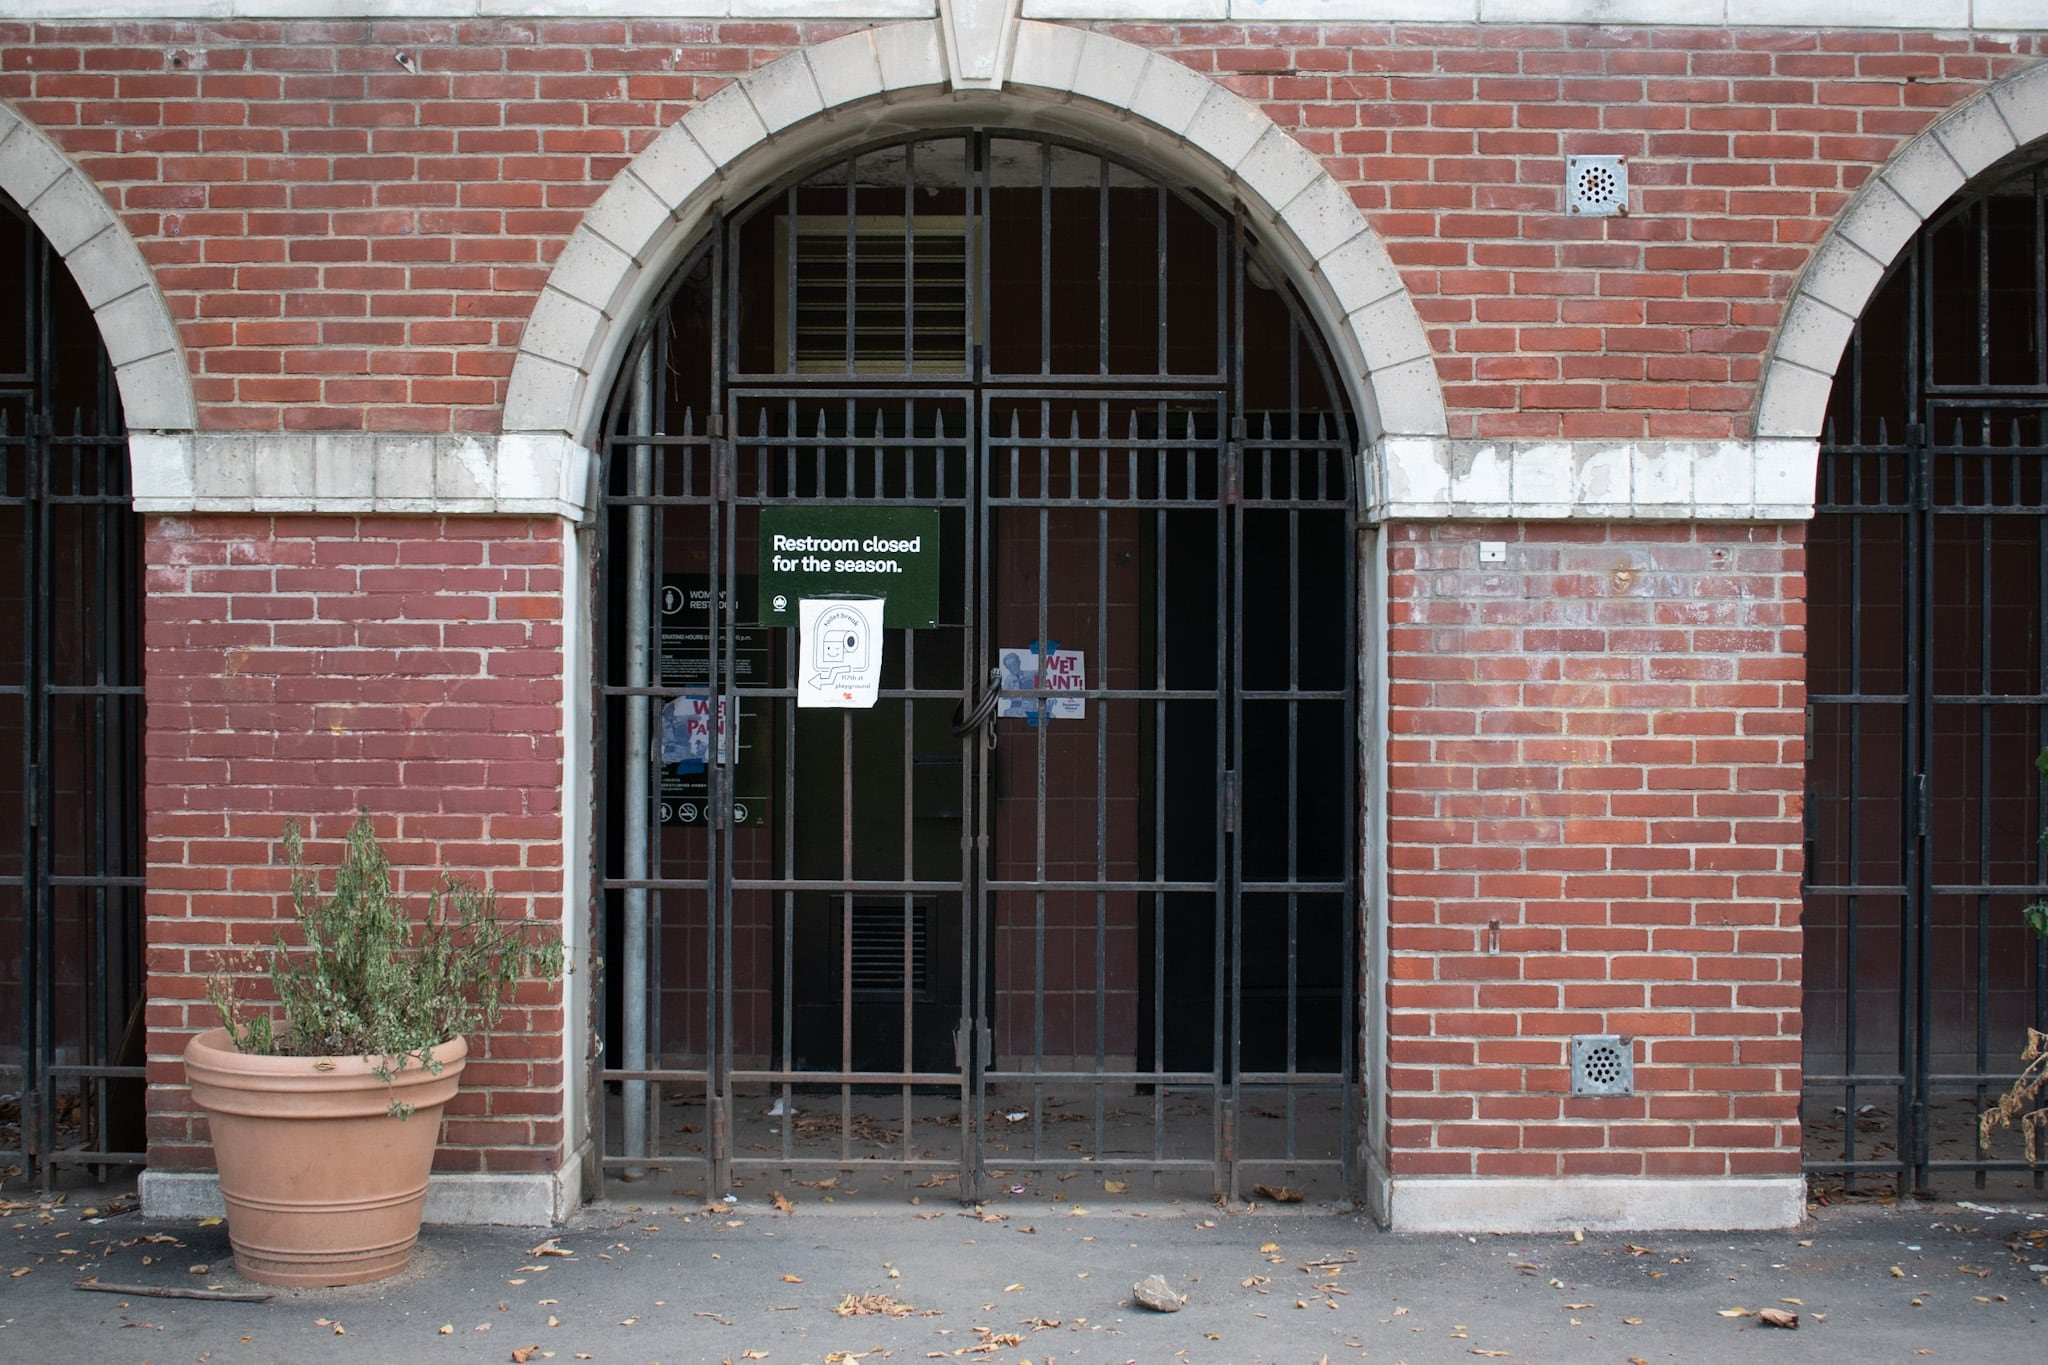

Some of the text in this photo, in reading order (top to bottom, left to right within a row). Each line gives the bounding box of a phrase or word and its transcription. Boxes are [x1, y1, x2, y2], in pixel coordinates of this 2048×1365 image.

[773, 534, 921, 553] Restroom closed
[772, 555, 903, 573] for the season.
[690, 590, 729, 599] WOMN'
[690, 600, 739, 610] RESTO
[824, 612, 859, 627] toilet break
[1045, 655, 1077, 674] WET
[835, 682, 871, 690] playground
